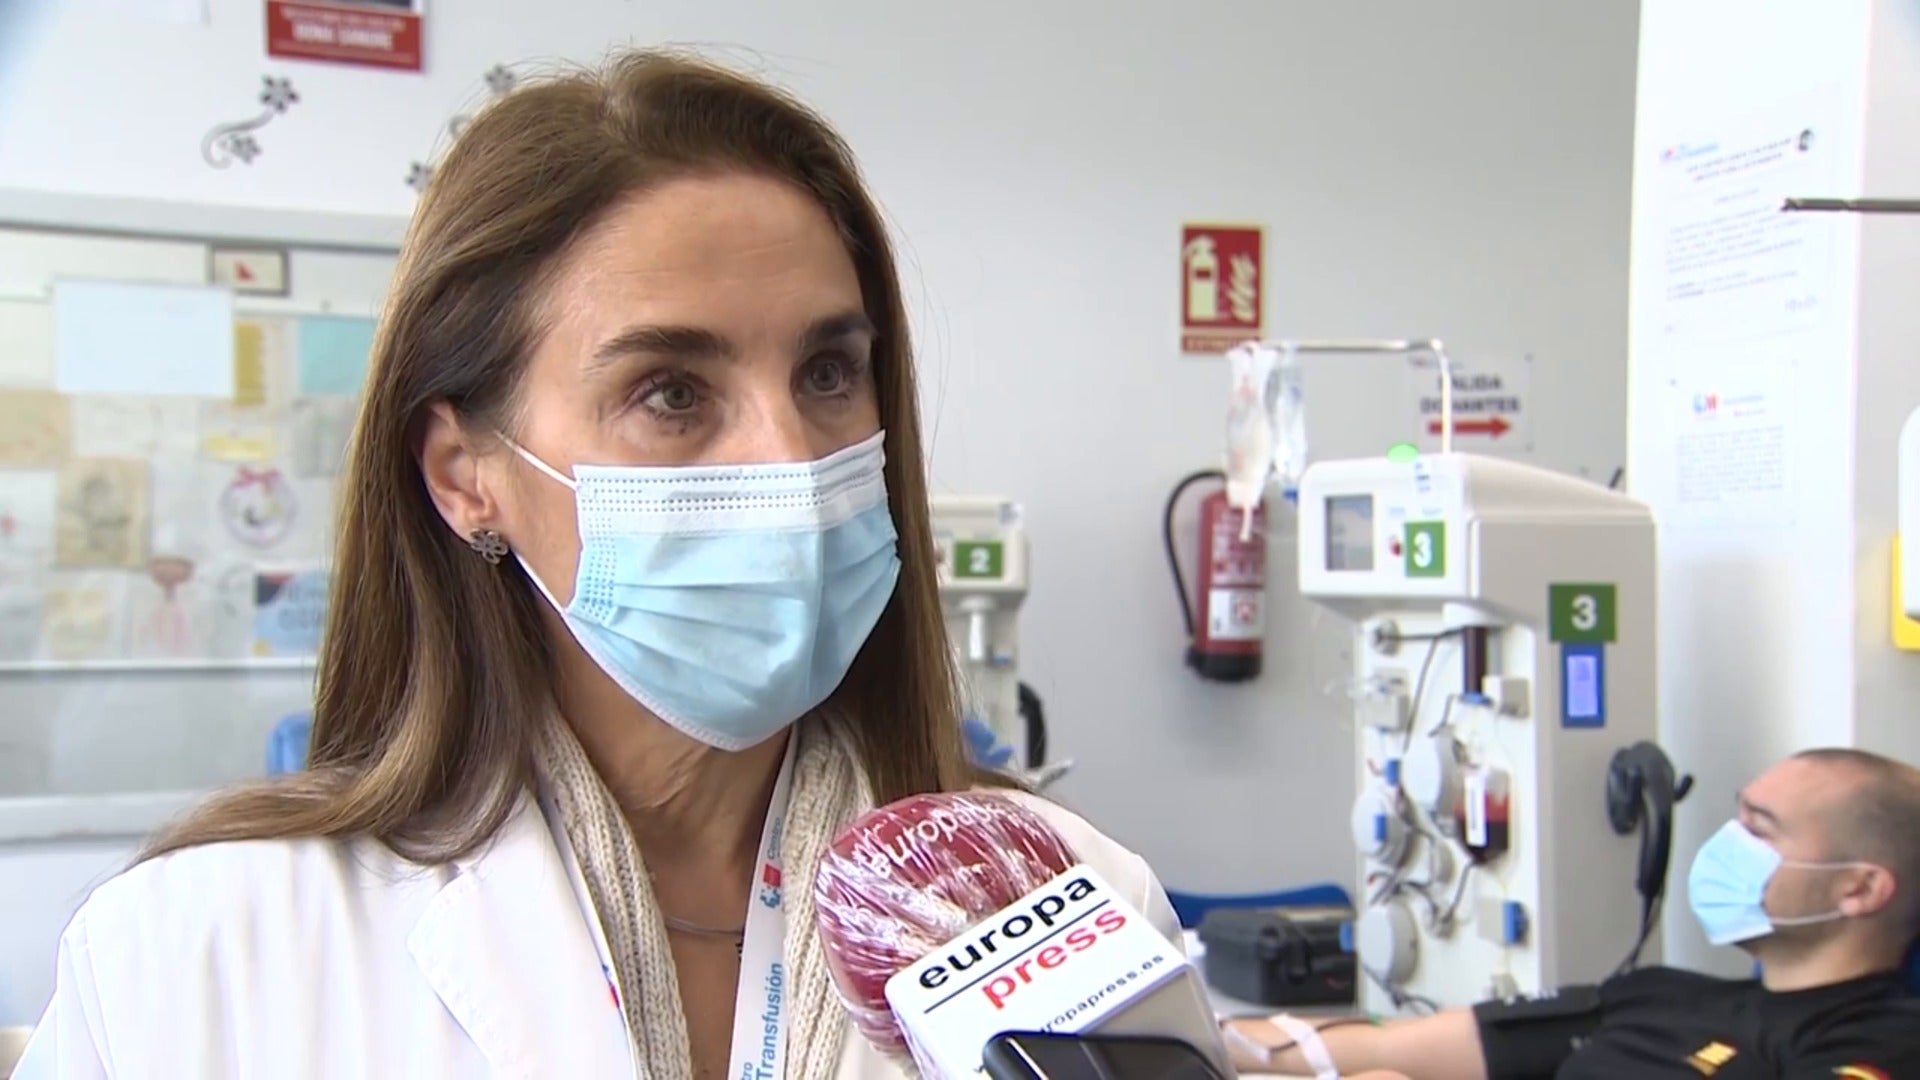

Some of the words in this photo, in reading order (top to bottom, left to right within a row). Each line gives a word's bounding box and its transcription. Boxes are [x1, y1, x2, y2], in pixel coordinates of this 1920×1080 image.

[1437, 374, 1502, 390] ALIDA
[969, 547, 990, 573] 2
[1413, 531, 1432, 568] 3
[1571, 594, 1597, 631] 3
[918, 876, 1098, 990] europa
[980, 908, 1128, 1011] press
[755, 962, 783, 1080] Transfusión
